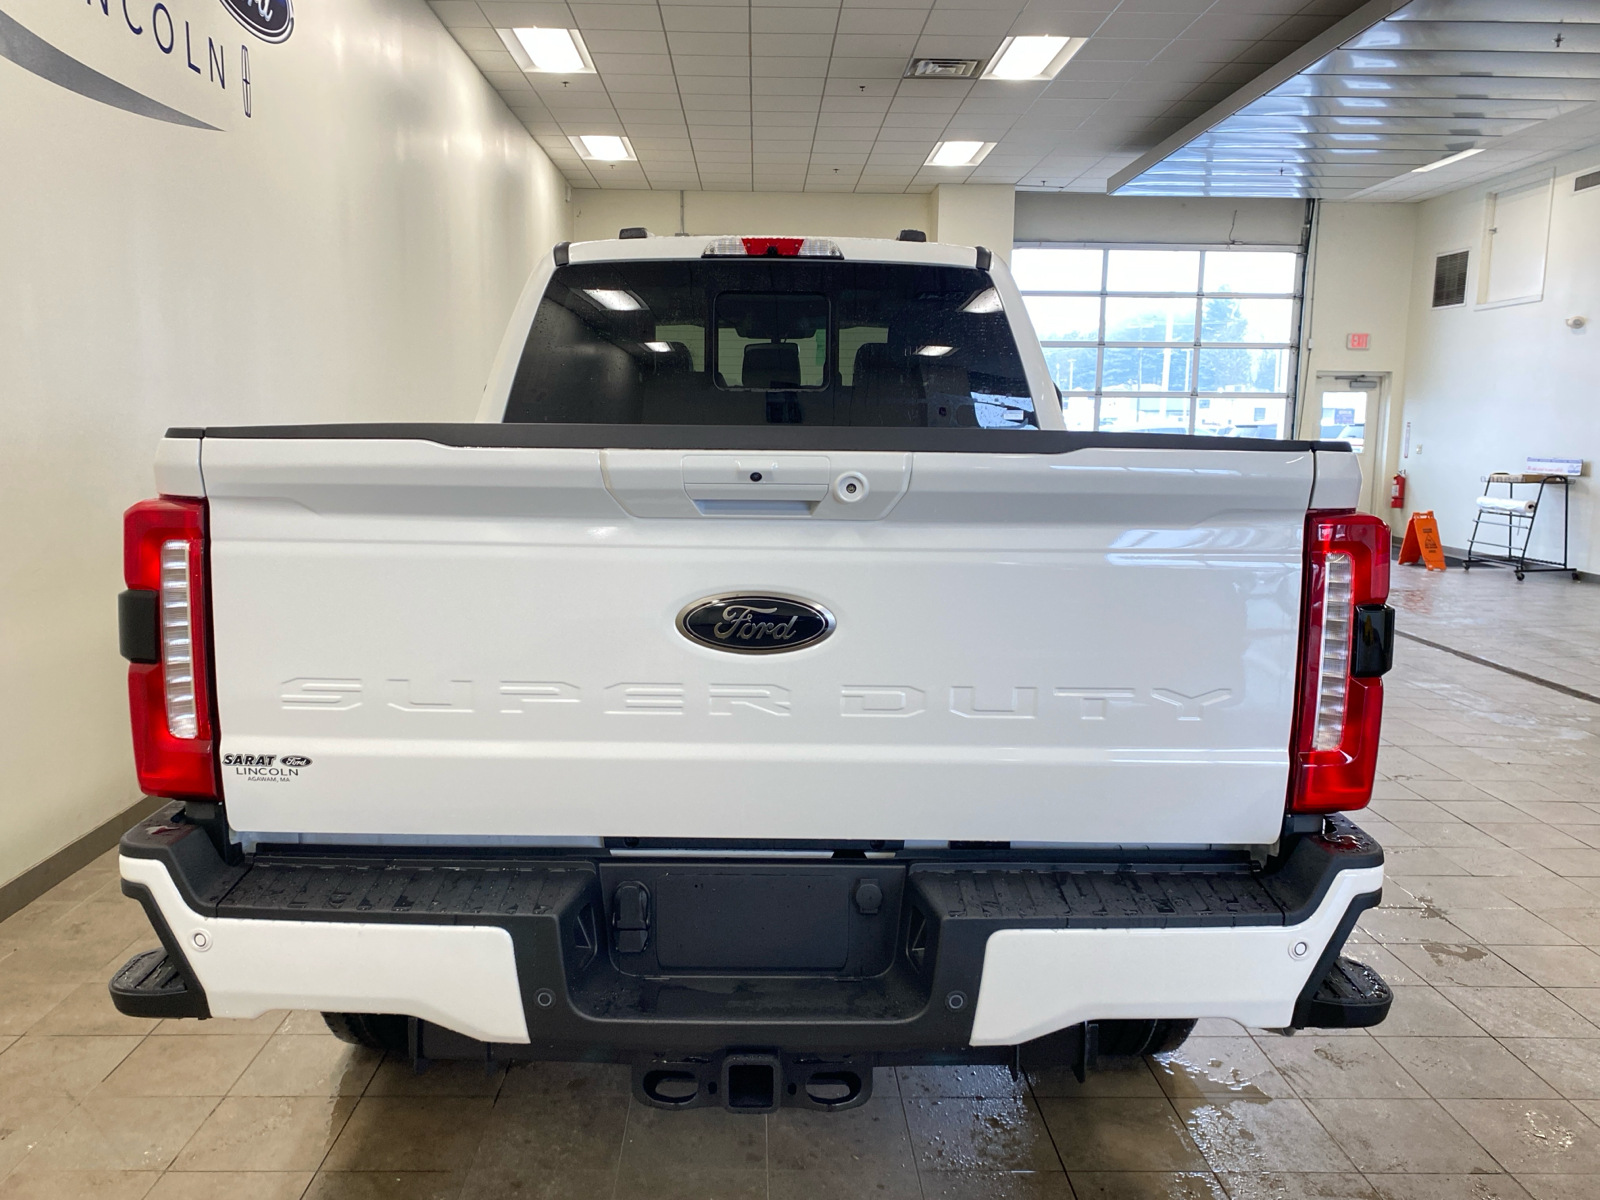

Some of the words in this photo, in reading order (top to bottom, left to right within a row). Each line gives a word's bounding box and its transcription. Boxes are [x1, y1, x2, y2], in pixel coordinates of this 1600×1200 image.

[1351, 333, 1369, 348] EXIT
[713, 605, 799, 640] Ford
[281, 677, 791, 717] SUPER
[840, 684, 1232, 721] DUTY
[223, 753, 276, 767] SARAT
[236, 767, 299, 776] LINCOLN
